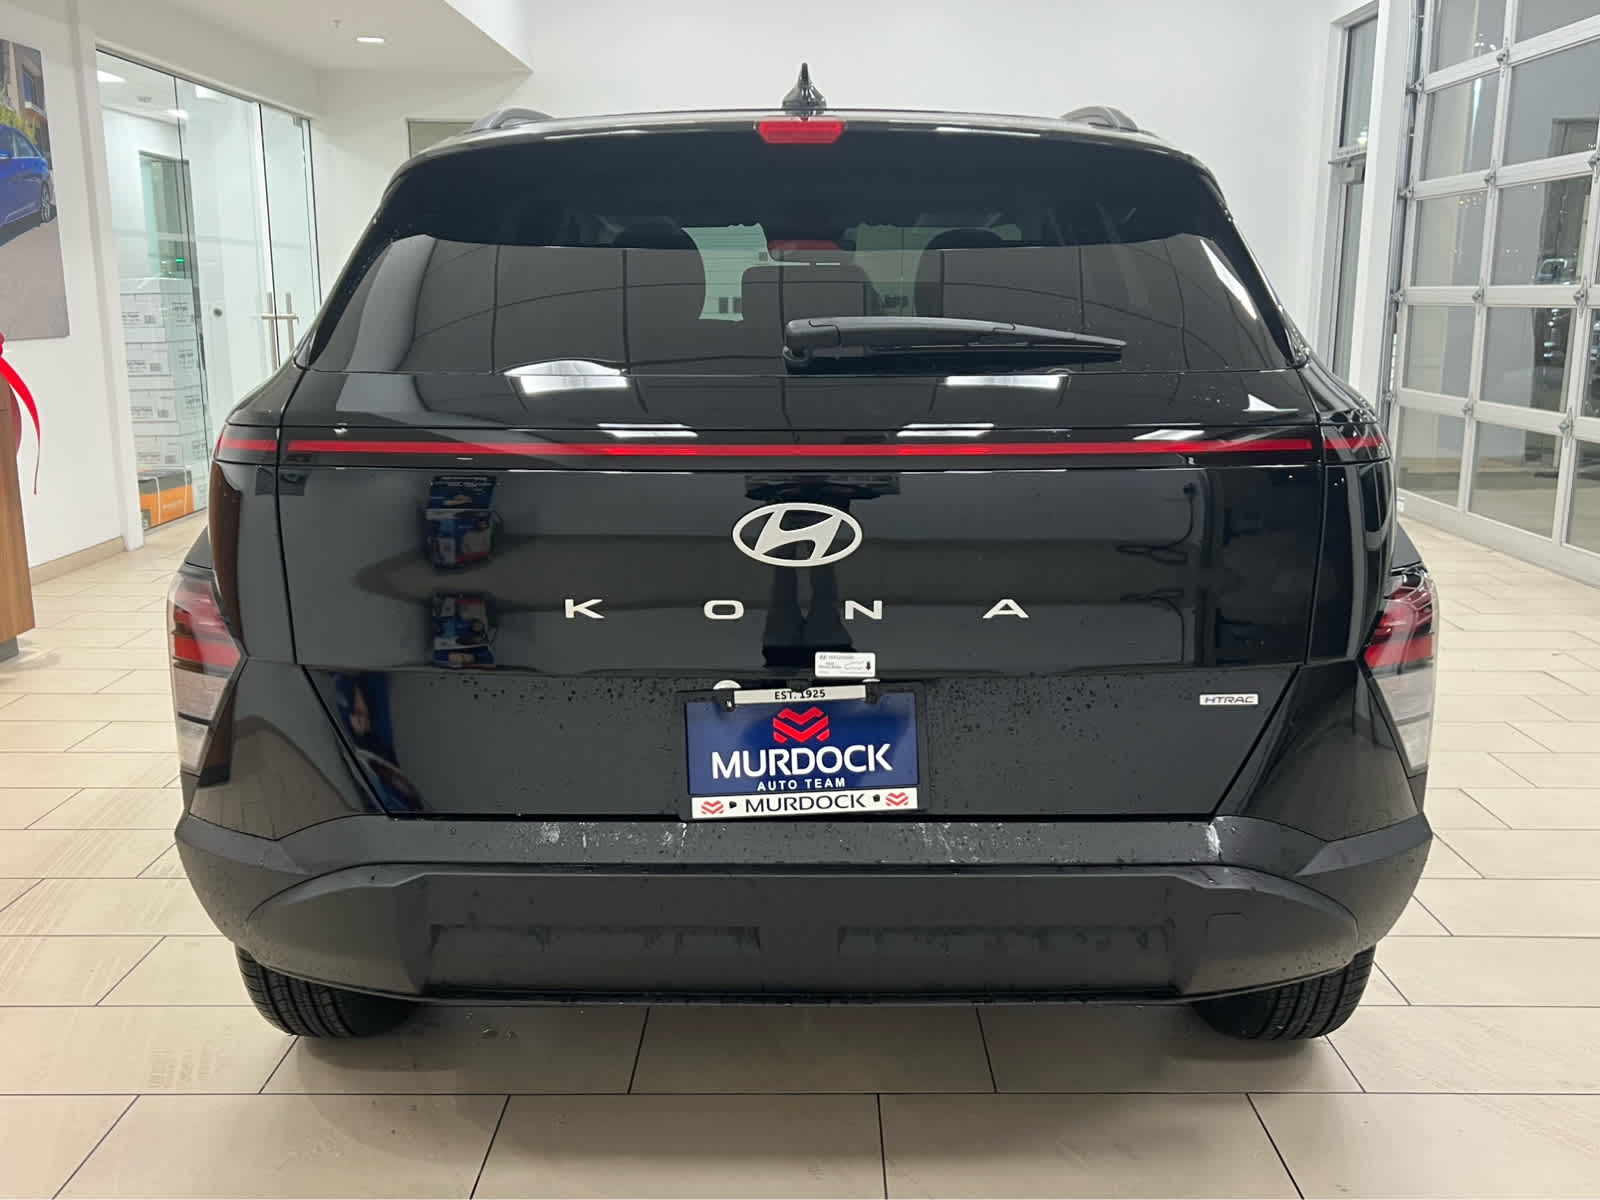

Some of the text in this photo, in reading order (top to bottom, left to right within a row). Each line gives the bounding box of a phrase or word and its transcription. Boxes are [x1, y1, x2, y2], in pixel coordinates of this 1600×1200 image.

[564, 598, 1030, 621] KONA
[774, 689, 826, 701] EST. 1925
[1204, 695, 1256, 704] HTRAC
[711, 743, 893, 780] MURDOCK
[757, 777, 846, 791] AUTO TEAM
[745, 793, 866, 813] MURDOCK
